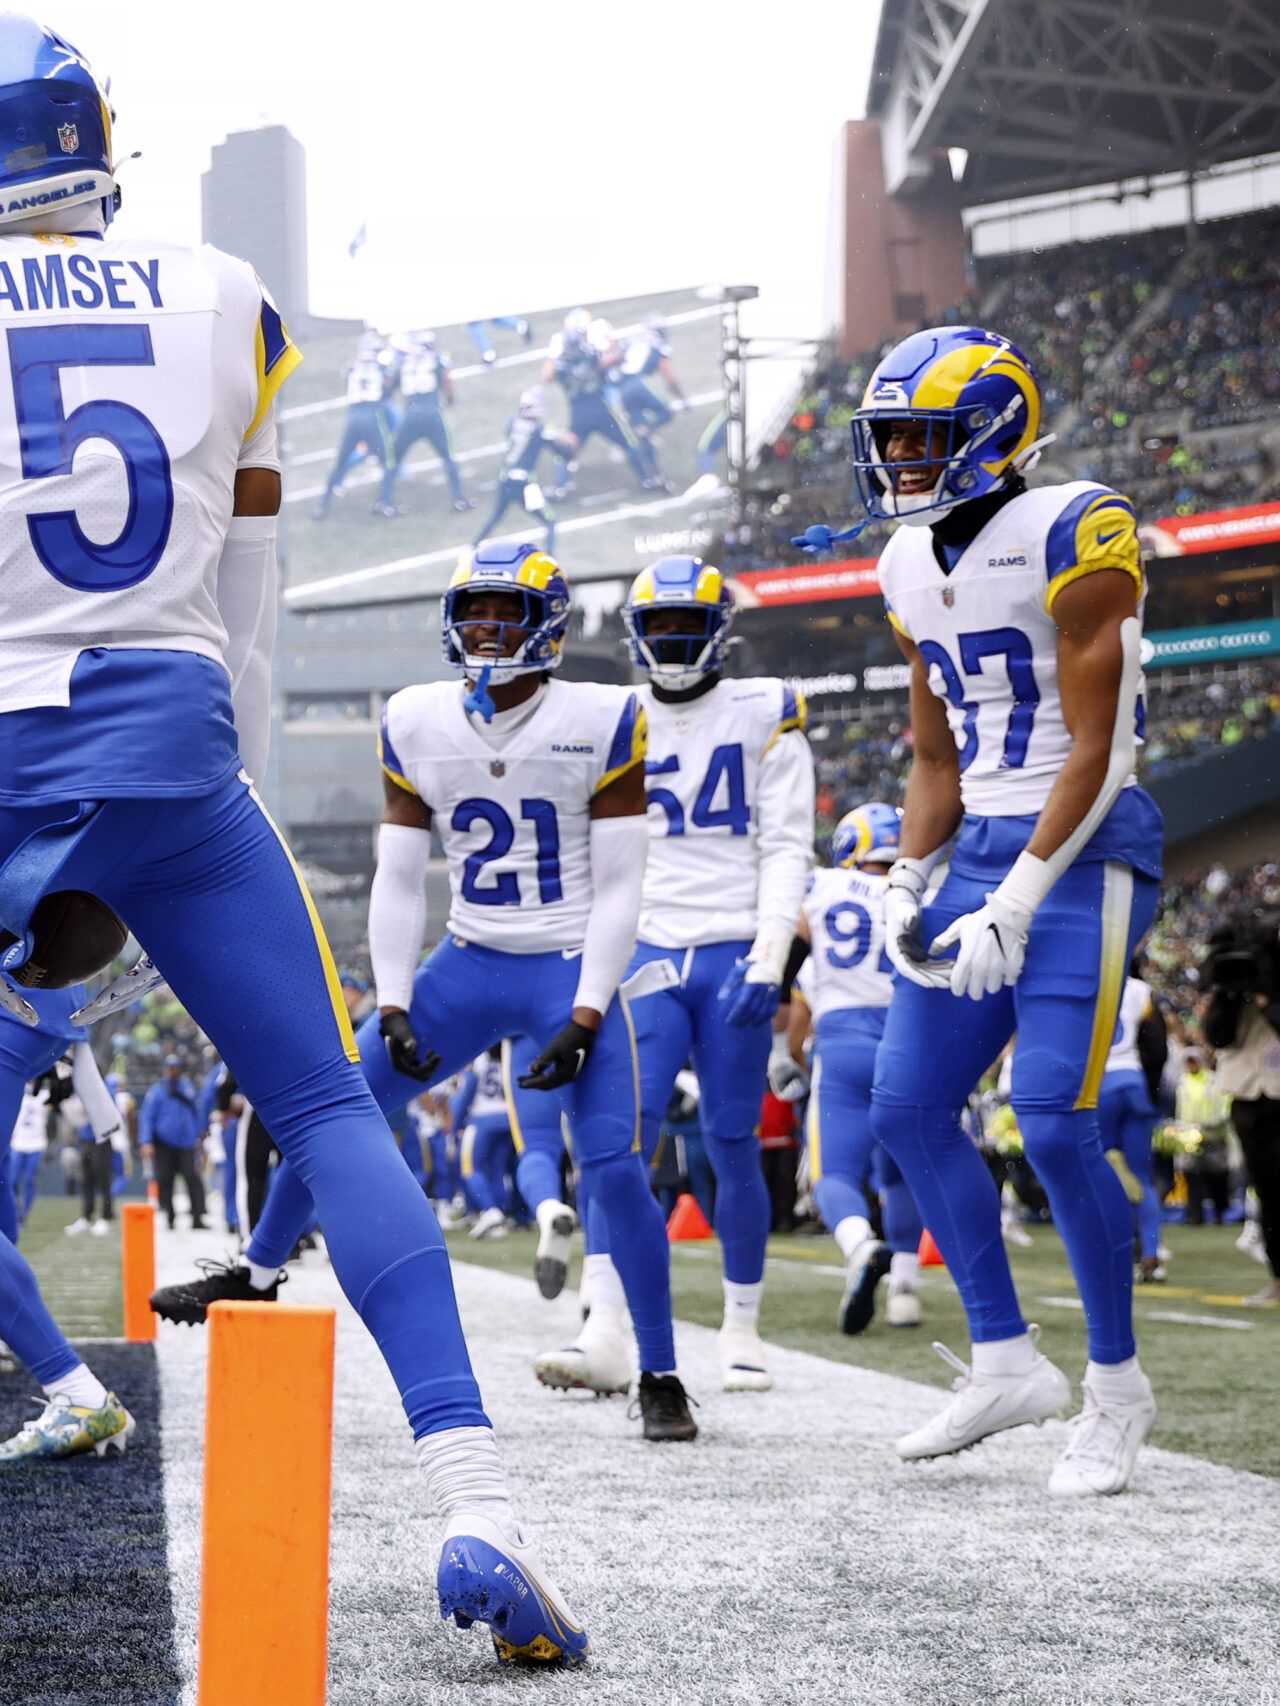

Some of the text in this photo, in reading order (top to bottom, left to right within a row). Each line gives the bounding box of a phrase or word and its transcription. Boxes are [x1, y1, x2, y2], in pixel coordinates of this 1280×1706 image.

[8, 180, 97, 212] ANGELES
[6, 323, 174, 593] 5
[988, 555, 1027, 568] RAMS
[551, 744, 595, 754] RAMS
[451, 796, 564, 906] 21
[504, 1567, 528, 1597] VAPOR
